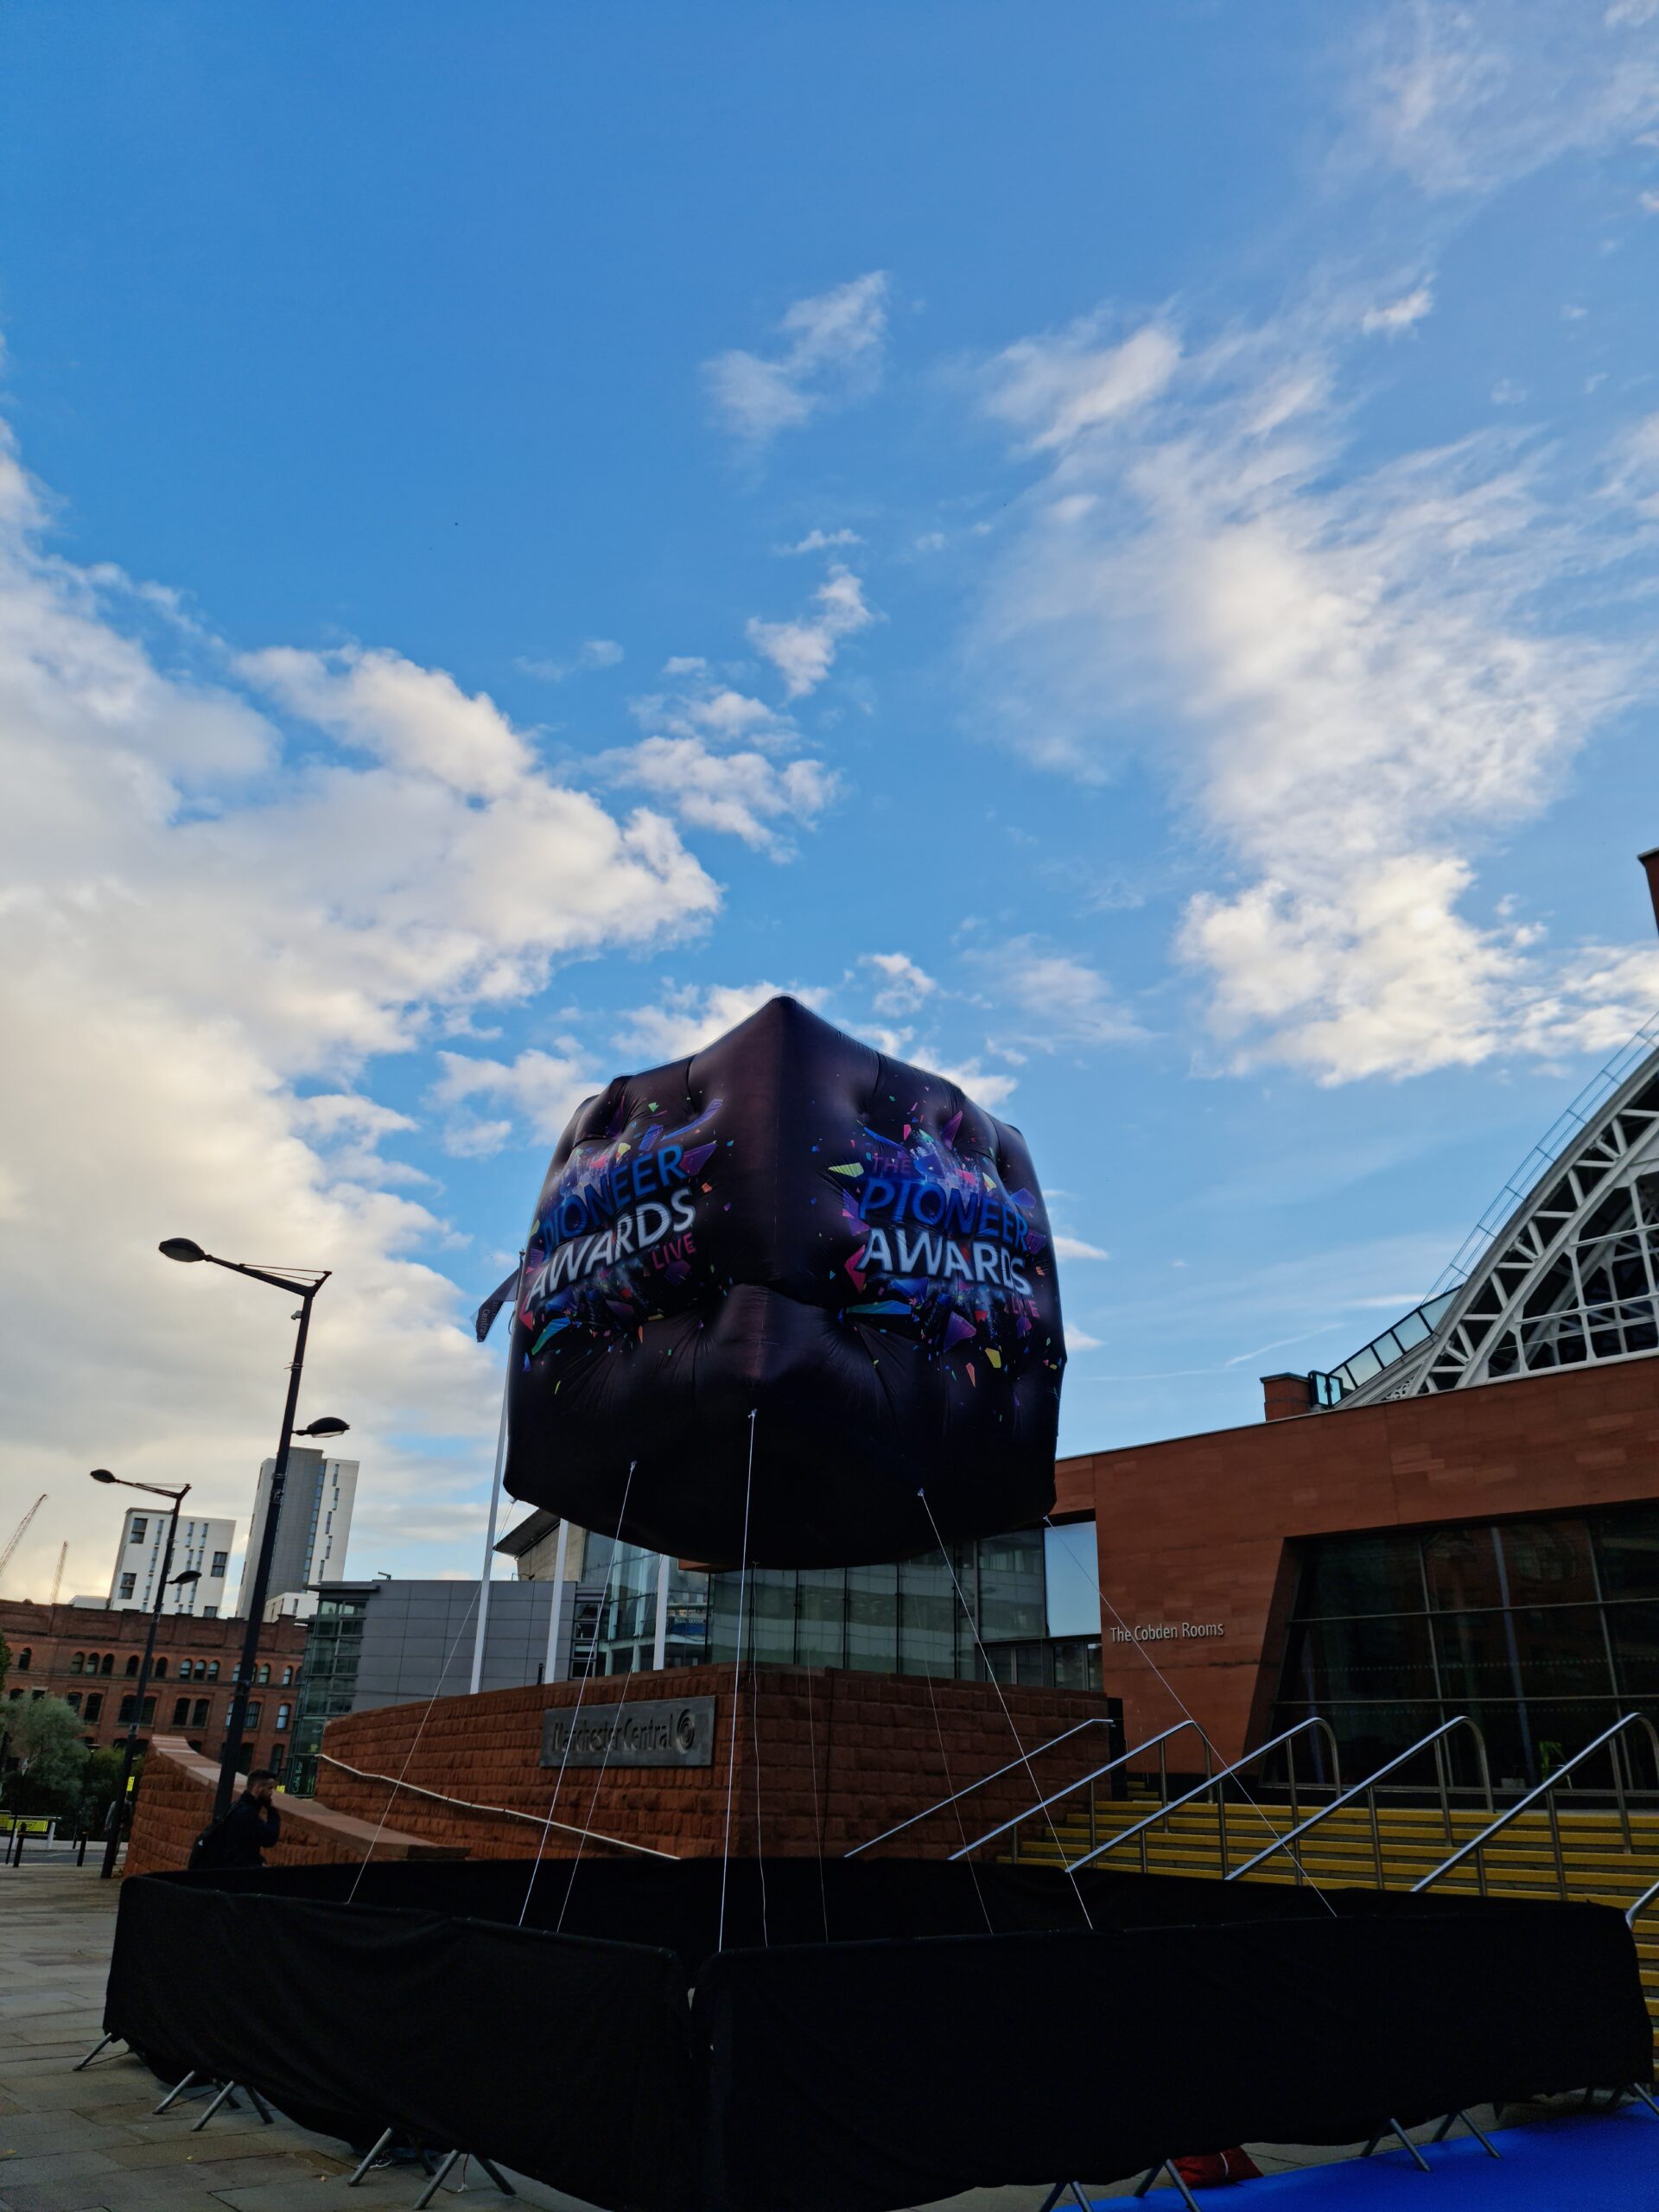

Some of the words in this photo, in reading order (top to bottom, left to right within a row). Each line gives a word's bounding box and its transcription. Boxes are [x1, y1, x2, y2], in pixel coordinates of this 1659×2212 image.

[857, 1178, 1029, 1252] PIONEER
[524, 1187, 696, 1313] AWARDS
[651, 1231, 696, 1271] LIVE
[855, 1227, 1033, 1296] AWARDS
[1109, 1626, 1132, 1643] The
[1135, 1624, 1178, 1641] Cobden
[1181, 1622, 1224, 1638] Rooms
[622, 1713, 674, 1751] Central
